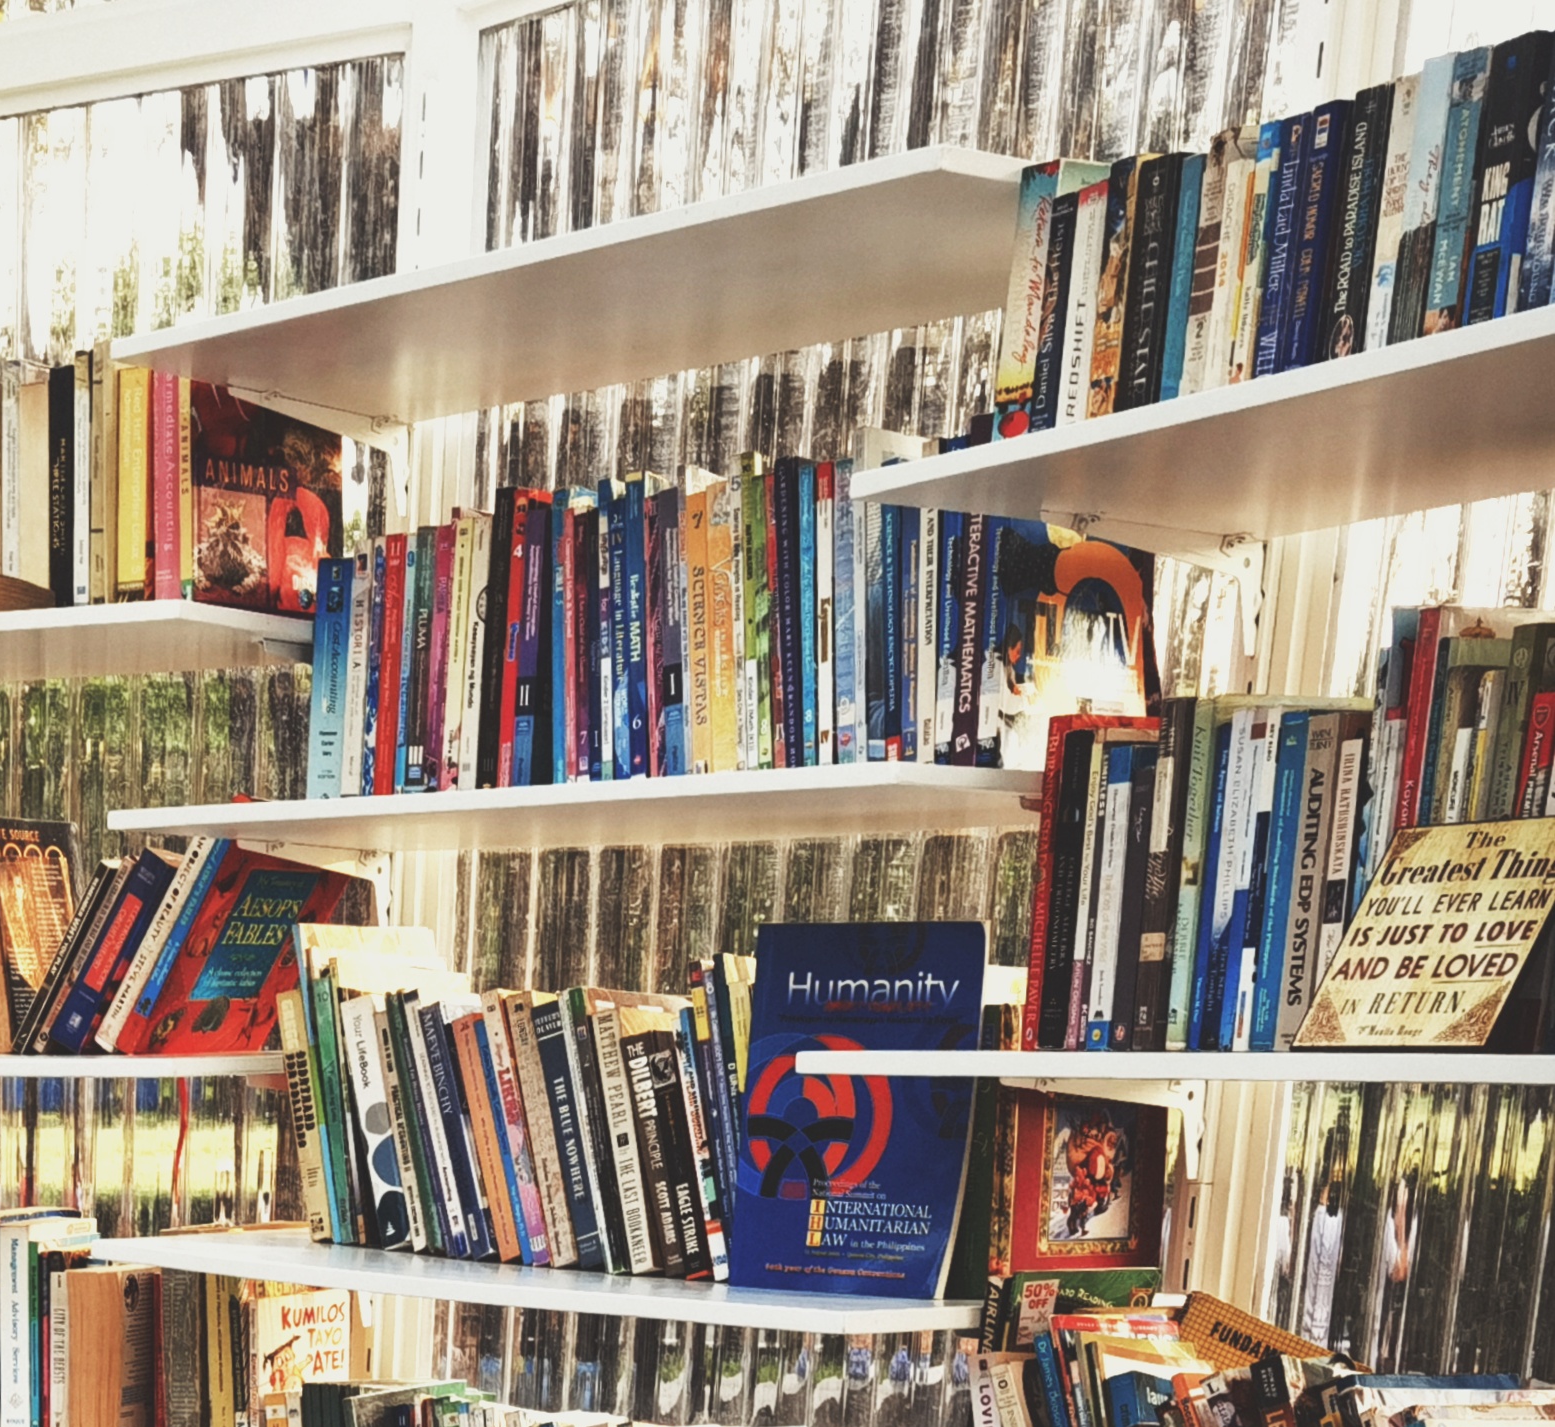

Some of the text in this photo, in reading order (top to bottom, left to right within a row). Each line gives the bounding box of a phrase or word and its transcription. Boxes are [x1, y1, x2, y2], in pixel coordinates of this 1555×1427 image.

[1450, 107, 1471, 207] ATONEMENT
[1482, 159, 1510, 201] KING
[1476, 199, 1505, 245] RAT
[1447, 255, 1458, 282] IAN
[1066, 299, 1087, 418] REDSHIFT
[180, 424, 189, 495] ANIMALS
[206, 458, 289, 493] ANIMALS
[163, 461, 175, 551] Accounting
[416, 608, 429, 649] PLUMA
[629, 621, 641, 662] MATH
[959, 601, 979, 714] MATHEMATICS
[1466, 831, 1506, 849] The
[1287, 768, 1325, 1006] AUDITING EDP SYSTEMS
[1380, 857, 1486, 887] Greatest
[1365, 888, 1553, 917] YOU'LL EVER LEARN
[66, 917, 82, 942] WHY
[1349, 920, 1538, 947] IS JUST TO LOVE
[1330, 953, 1519, 981] AND BE LOVED
[788, 971, 960, 1007] Humanity
[420, 1014, 453, 1114] MAEVE BINCHY
[595, 1014, 629, 1128] MATTHEW PEARL
[628, 1056, 658, 1120] DILBERT
[556, 1104, 573, 1137] BLUE
[644, 1119, 663, 1170] PRINCIPLE
[654, 1181, 671, 1211] SCOTT
[809, 1199, 932, 1219] INTERNATIONAL
[660, 1211, 677, 1245] ADAMS
[674, 1182, 700, 1255] EAGLE STRIKE
[808, 1214, 931, 1235] HUMANITARIAN
[806, 1230, 847, 1247] LAW
[1023, 1281, 1057, 1299] 50%
[1027, 1298, 1049, 1310] OFF
[280, 1301, 347, 1331] KUMILOS
[306, 1327, 344, 1349] TAYO
